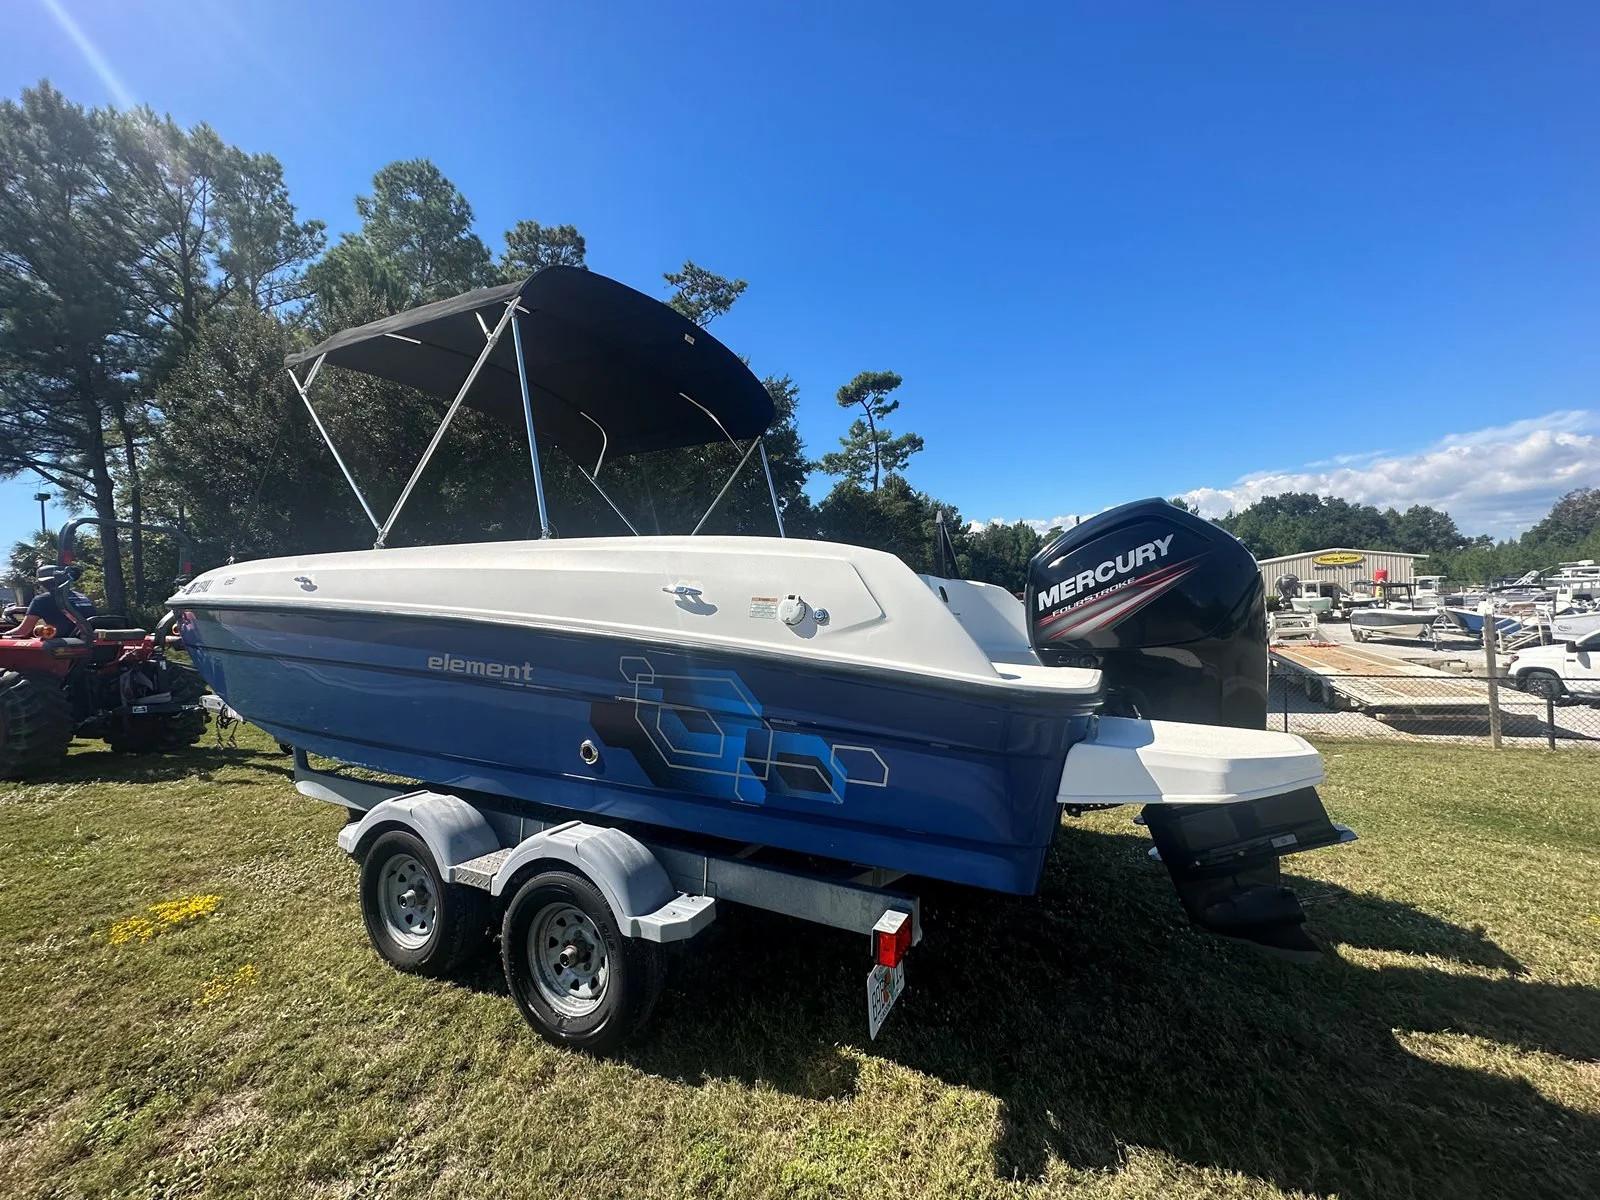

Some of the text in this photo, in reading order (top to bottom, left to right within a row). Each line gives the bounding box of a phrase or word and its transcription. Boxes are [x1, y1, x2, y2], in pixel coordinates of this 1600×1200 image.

[1038, 534, 1174, 611] MERCURY
[1052, 577, 1137, 617] FOURSTROKE
[427, 653, 534, 681] element
